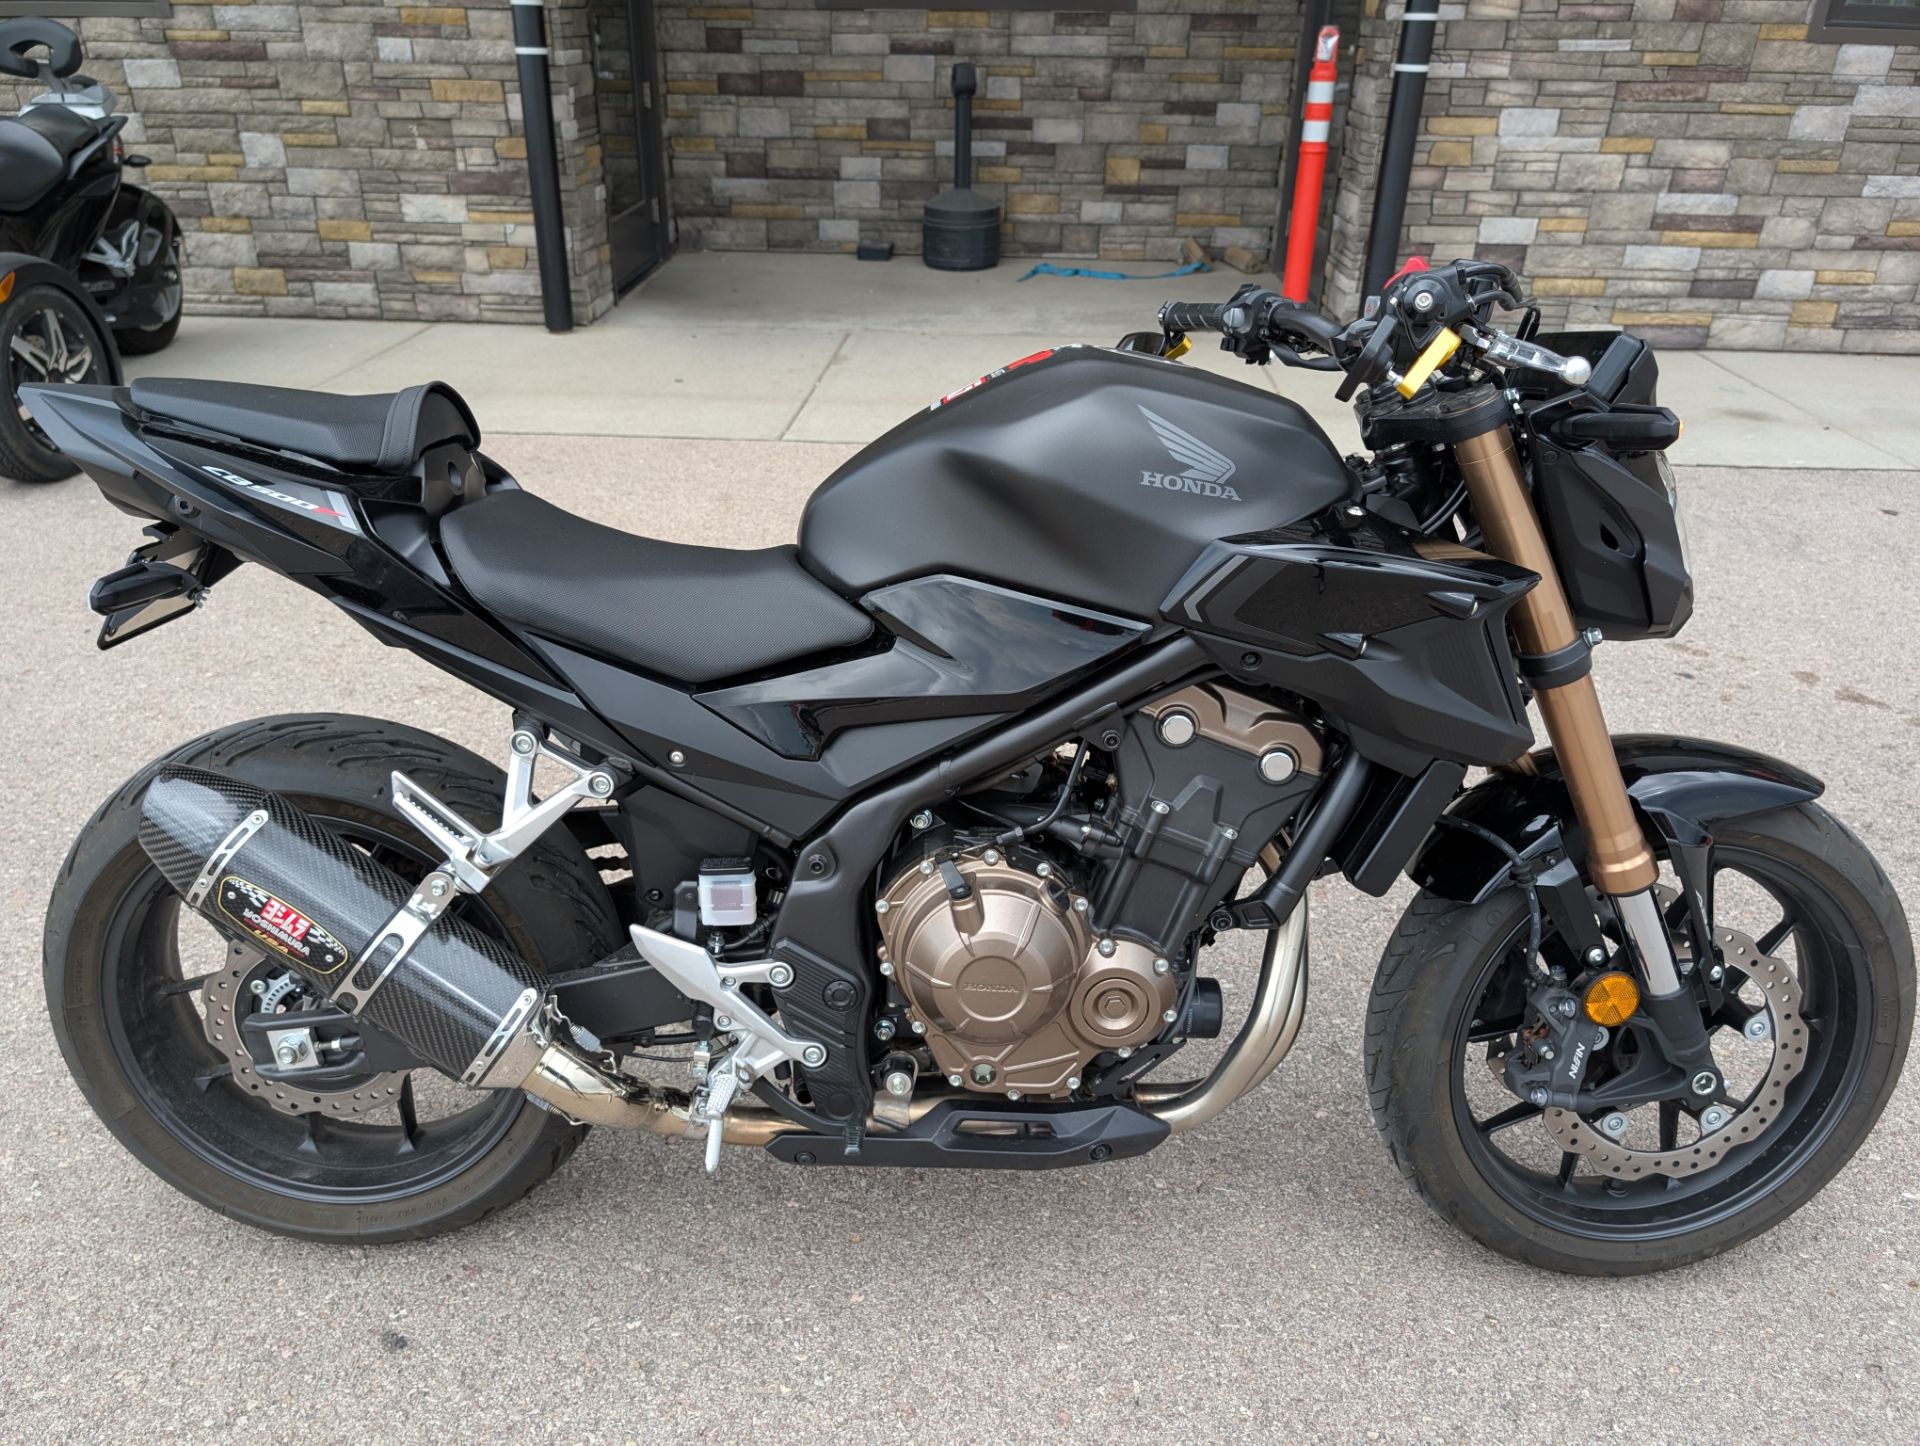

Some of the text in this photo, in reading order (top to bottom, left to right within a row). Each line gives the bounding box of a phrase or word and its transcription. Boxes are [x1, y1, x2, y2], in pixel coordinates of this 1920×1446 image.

[1140, 471, 1242, 502] HONDA
[242, 907, 311, 956] YOSHIMURA
[260, 897, 311, 939] ヨシムラ
[964, 983, 1019, 993] HONDA
